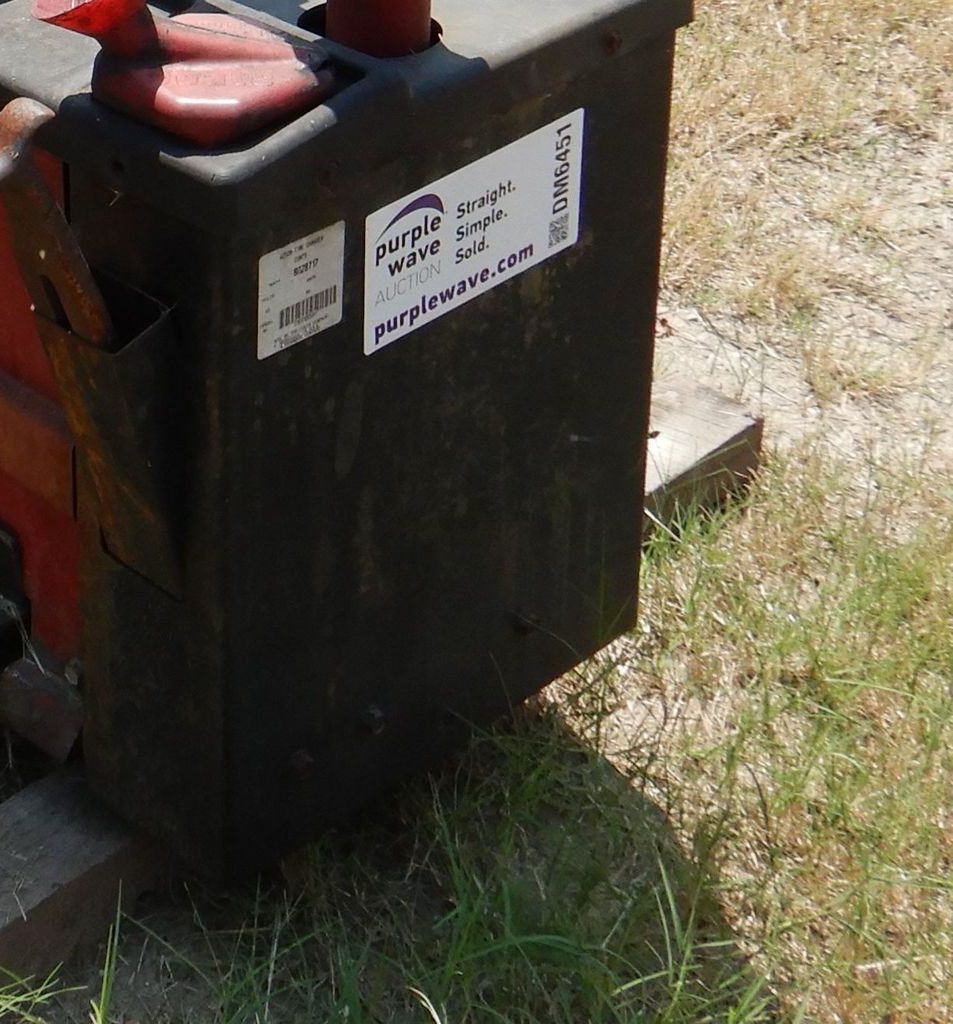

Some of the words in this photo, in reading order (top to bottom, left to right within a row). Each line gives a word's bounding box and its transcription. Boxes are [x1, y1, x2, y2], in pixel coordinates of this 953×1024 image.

[552, 122, 572, 215] DM6451
[456, 179, 516, 220] Straight.
[375, 214, 442, 267] purple
[455, 206, 508, 242] Simple.
[388, 239, 441, 277] wave
[455, 235, 490, 265] Sold.
[374, 260, 442, 307] AUCTION
[374, 242, 535, 345] purplewave.com
